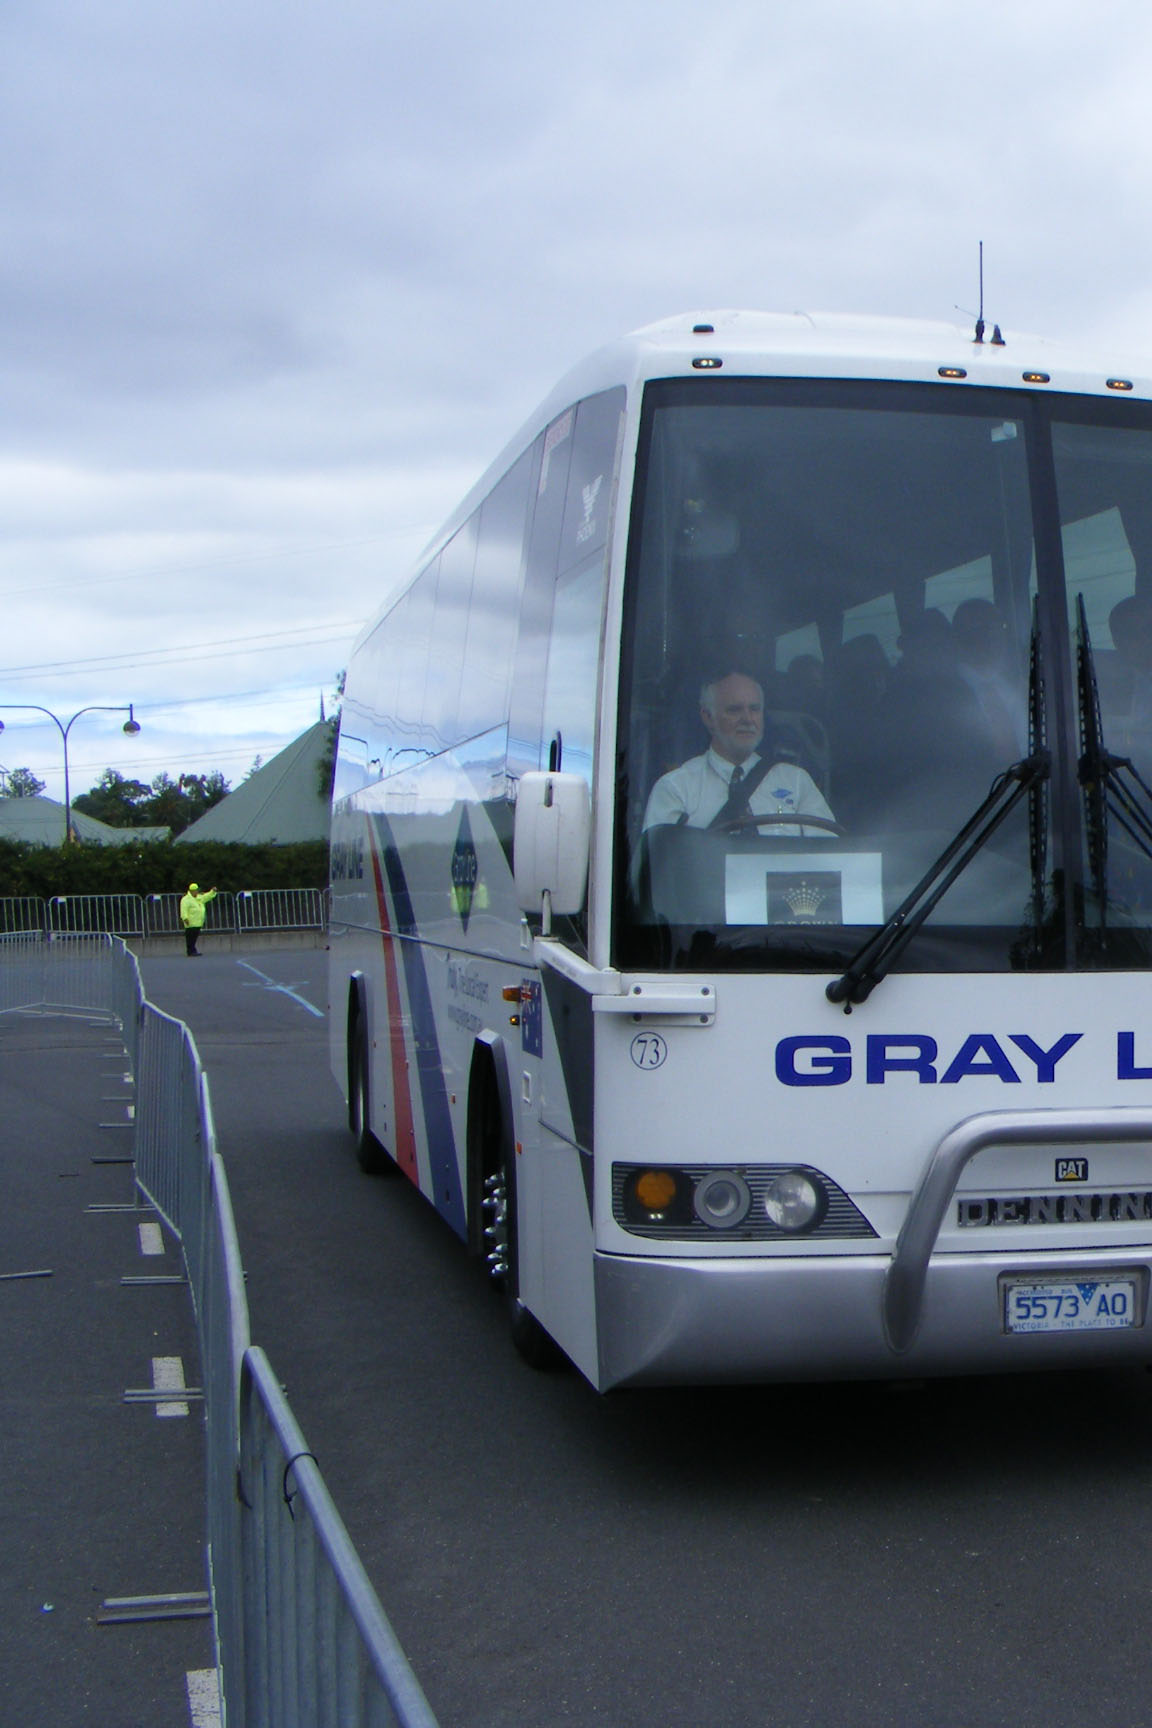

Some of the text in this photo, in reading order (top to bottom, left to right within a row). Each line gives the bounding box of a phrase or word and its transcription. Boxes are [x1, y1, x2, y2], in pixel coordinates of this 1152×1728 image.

[637, 1038, 660, 1065] 73
[775, 1033, 1085, 1087] GRAY
[1057, 1160, 1086, 1179] CAT
[1016, 1295, 1079, 1320] 5573
[1013, 1321, 1049, 1331] VICTORIA
[1106, 1318, 1116, 1326] TO
